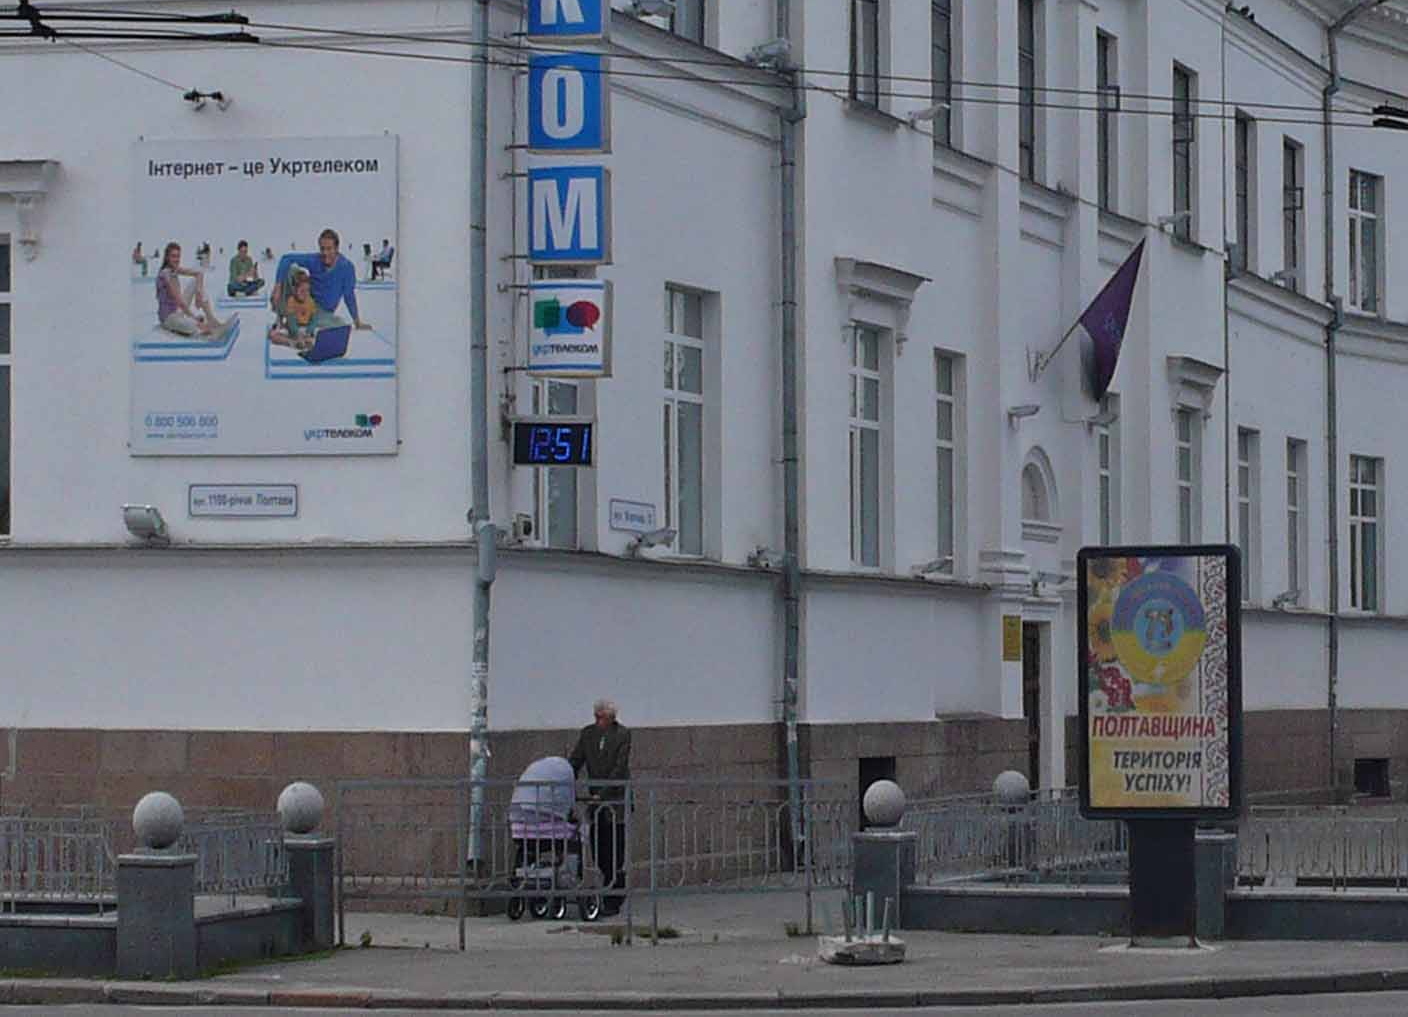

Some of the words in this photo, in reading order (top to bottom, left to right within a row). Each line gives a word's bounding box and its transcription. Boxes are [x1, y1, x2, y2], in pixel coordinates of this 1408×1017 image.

[148, 159, 225, 179] Інтернет
[243, 161, 265, 178] це
[269, 157, 379, 179] Укртелеком
[530, 427, 589, 461] 12:51
[1091, 715, 1217, 740] ПОЛТАВЩИНА
[1112, 750, 1202, 770] ТЕРИТОРІЯ
[1125, 773, 1192, 792] УСПІХУ!
